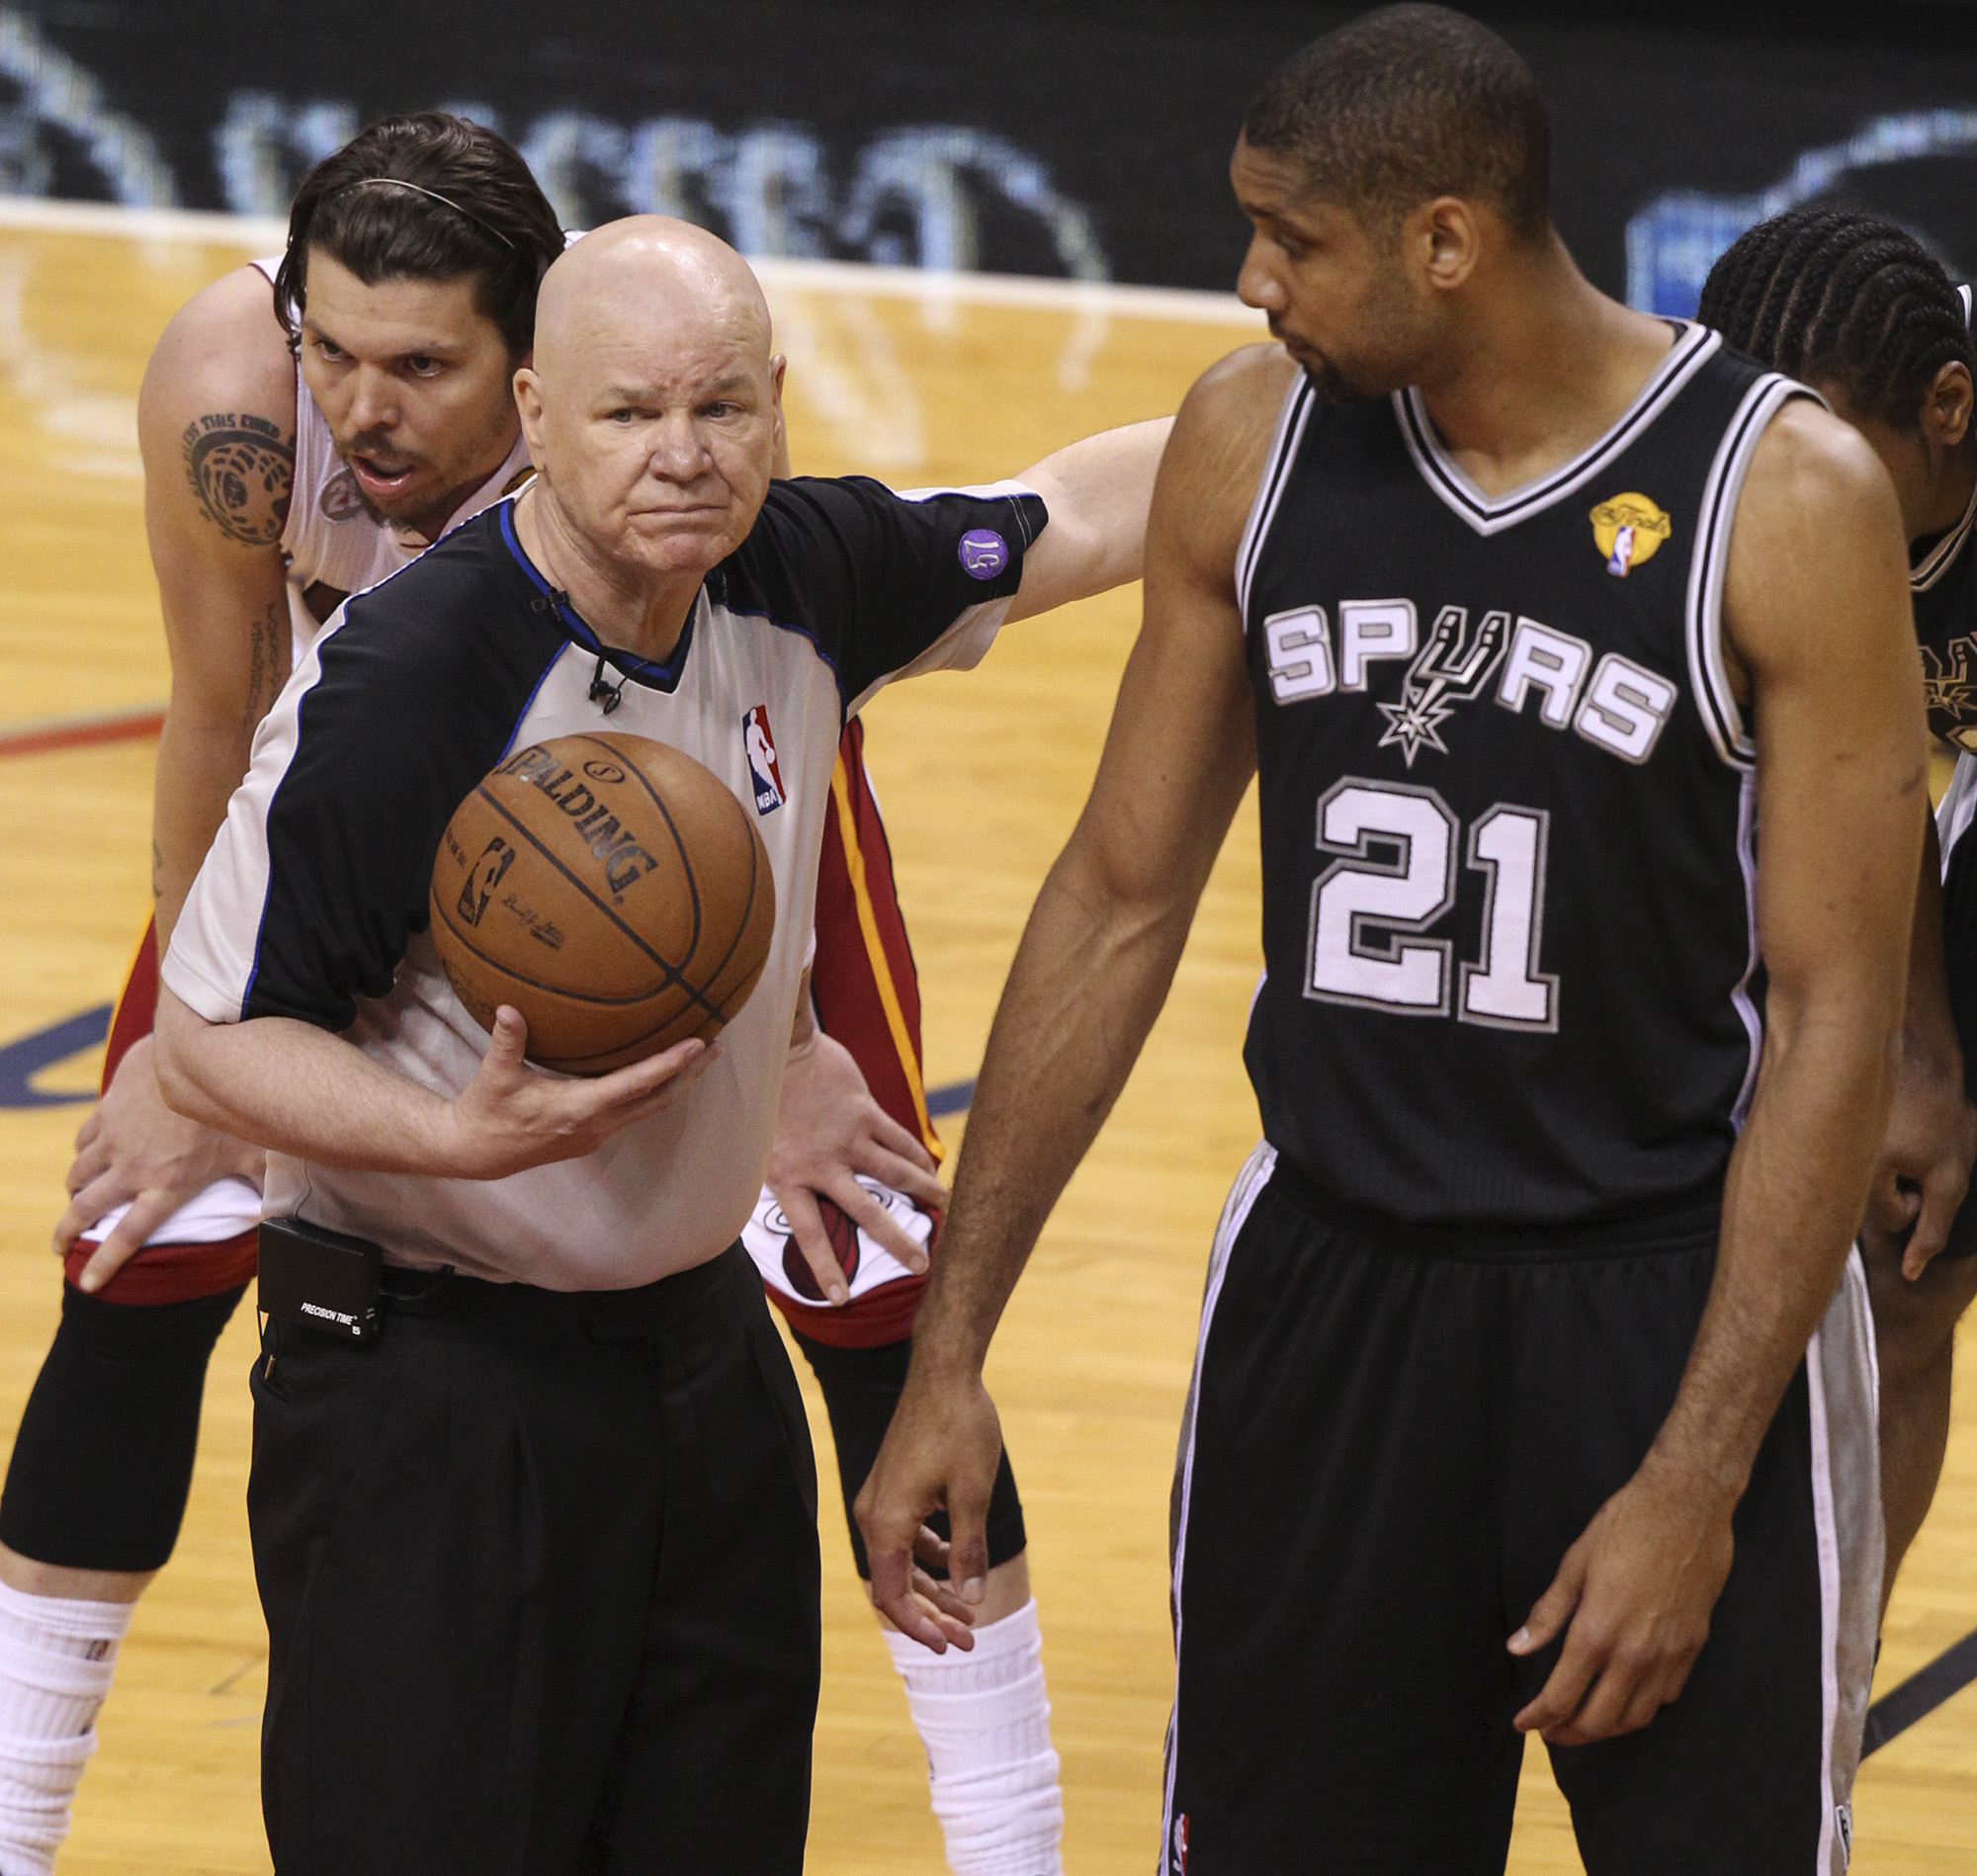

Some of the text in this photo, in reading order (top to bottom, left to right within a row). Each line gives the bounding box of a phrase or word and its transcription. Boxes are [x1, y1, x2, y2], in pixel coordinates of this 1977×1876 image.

[1264, 598, 1678, 768] SPURS
[755, 789, 778, 810] NBA
[1302, 775, 1560, 1034] 21
[301, 1302, 337, 1322] PRECISION
